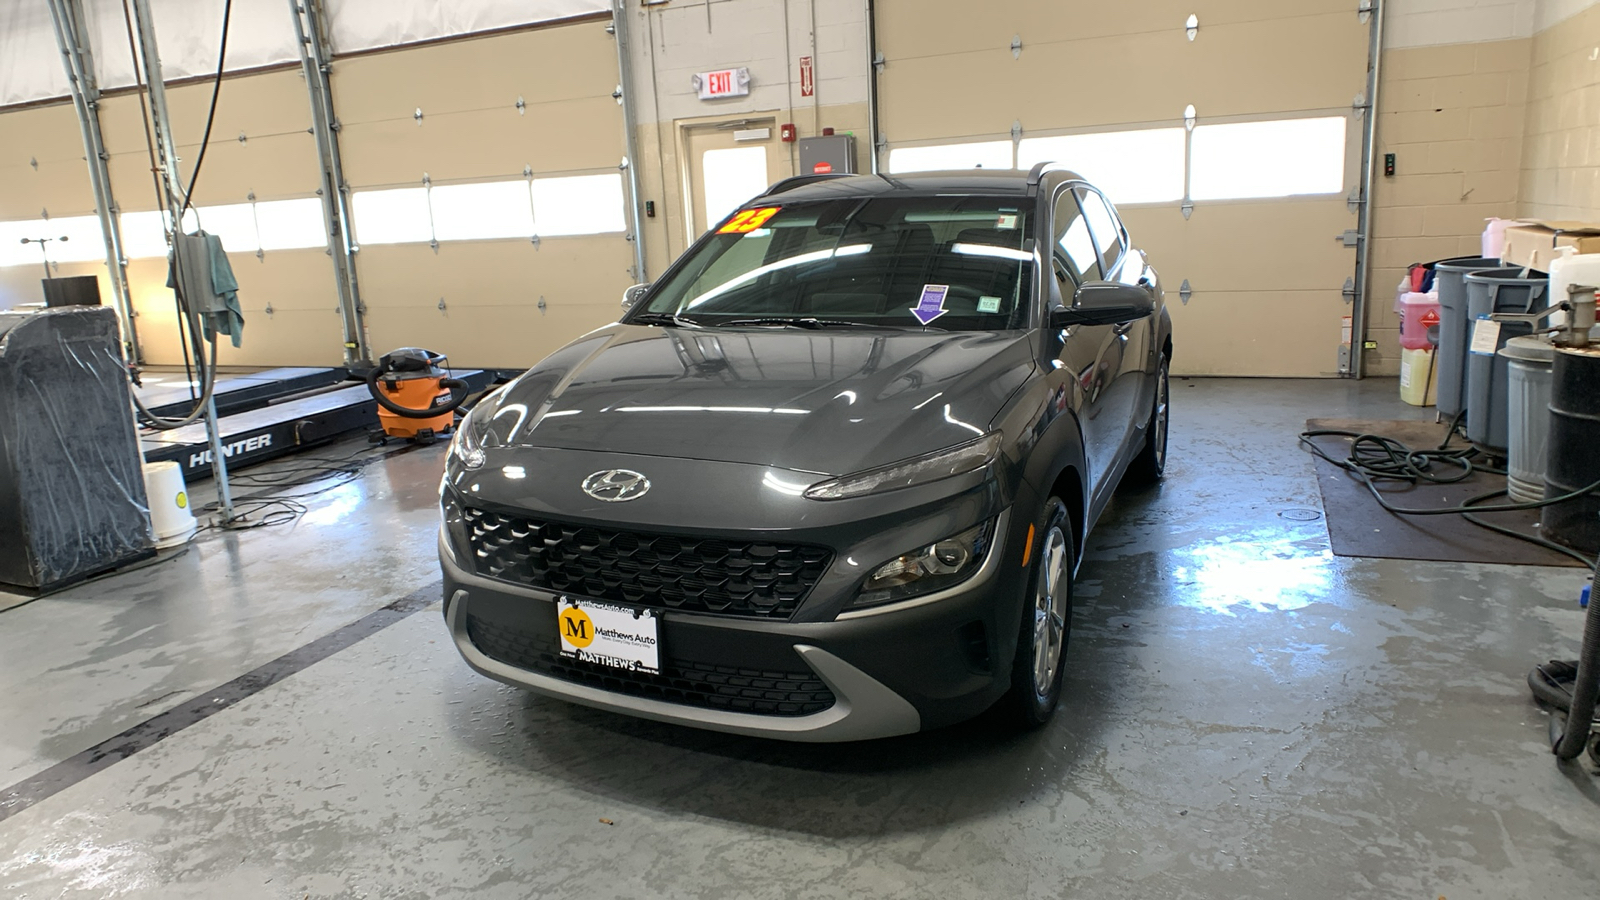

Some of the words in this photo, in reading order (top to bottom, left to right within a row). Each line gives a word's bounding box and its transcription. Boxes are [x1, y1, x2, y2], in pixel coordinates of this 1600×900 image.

[708, 71, 731, 94] EXIT
[719, 208, 777, 232] 23
[189, 433, 272, 468] HUNTER
[575, 599, 635, 615] MatthewsAuto.com
[564, 616, 589, 640] M
[594, 626, 634, 642] Matthews
[634, 634, 656, 645] Auto
[579, 651, 636, 671] MATTHEWS
